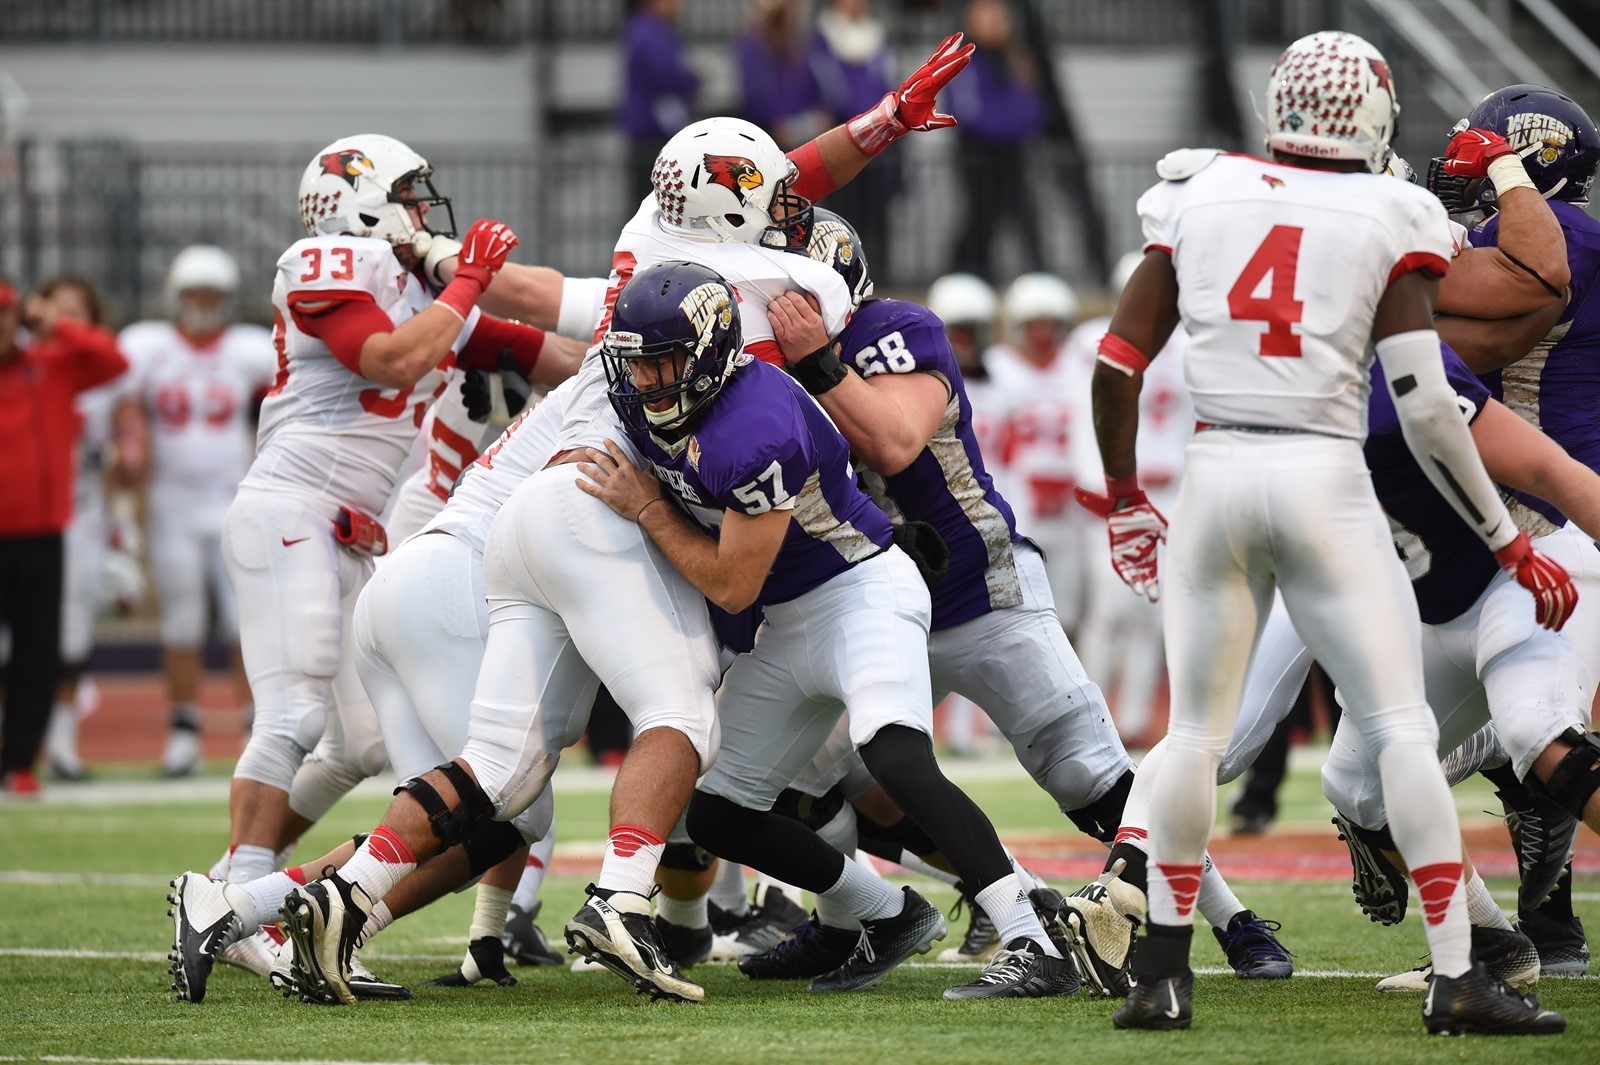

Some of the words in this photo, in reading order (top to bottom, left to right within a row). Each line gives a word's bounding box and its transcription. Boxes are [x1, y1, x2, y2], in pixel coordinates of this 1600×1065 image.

[1505, 113, 1574, 140] WESTERN
[301, 248, 354, 283] 33
[1227, 224, 1304, 358] 4
[855, 331, 916, 378] 68
[732, 460, 790, 515] 57
[594, 899, 613, 915] NIKE
[1069, 884, 1108, 905] IKE
